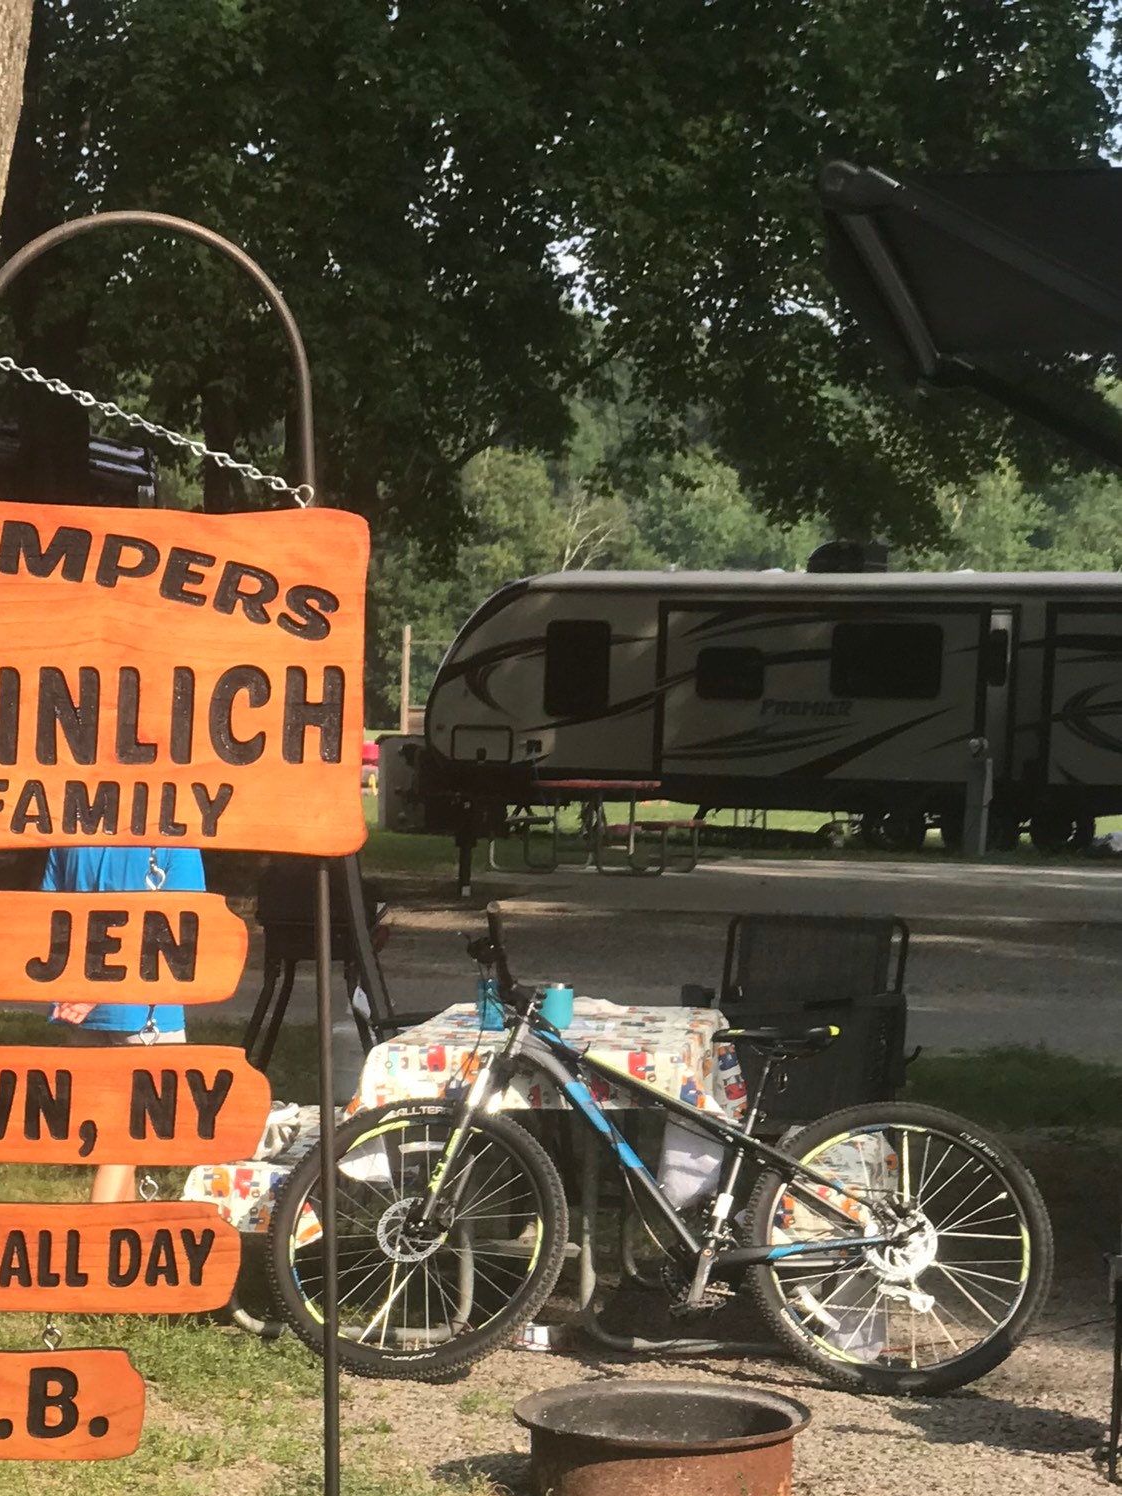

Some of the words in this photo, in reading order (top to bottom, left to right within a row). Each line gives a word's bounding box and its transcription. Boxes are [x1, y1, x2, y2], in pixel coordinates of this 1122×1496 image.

[25, 911, 199, 983] JEN
[130, 1070, 234, 1140] NY
[108, 1229, 217, 1288] DAY
